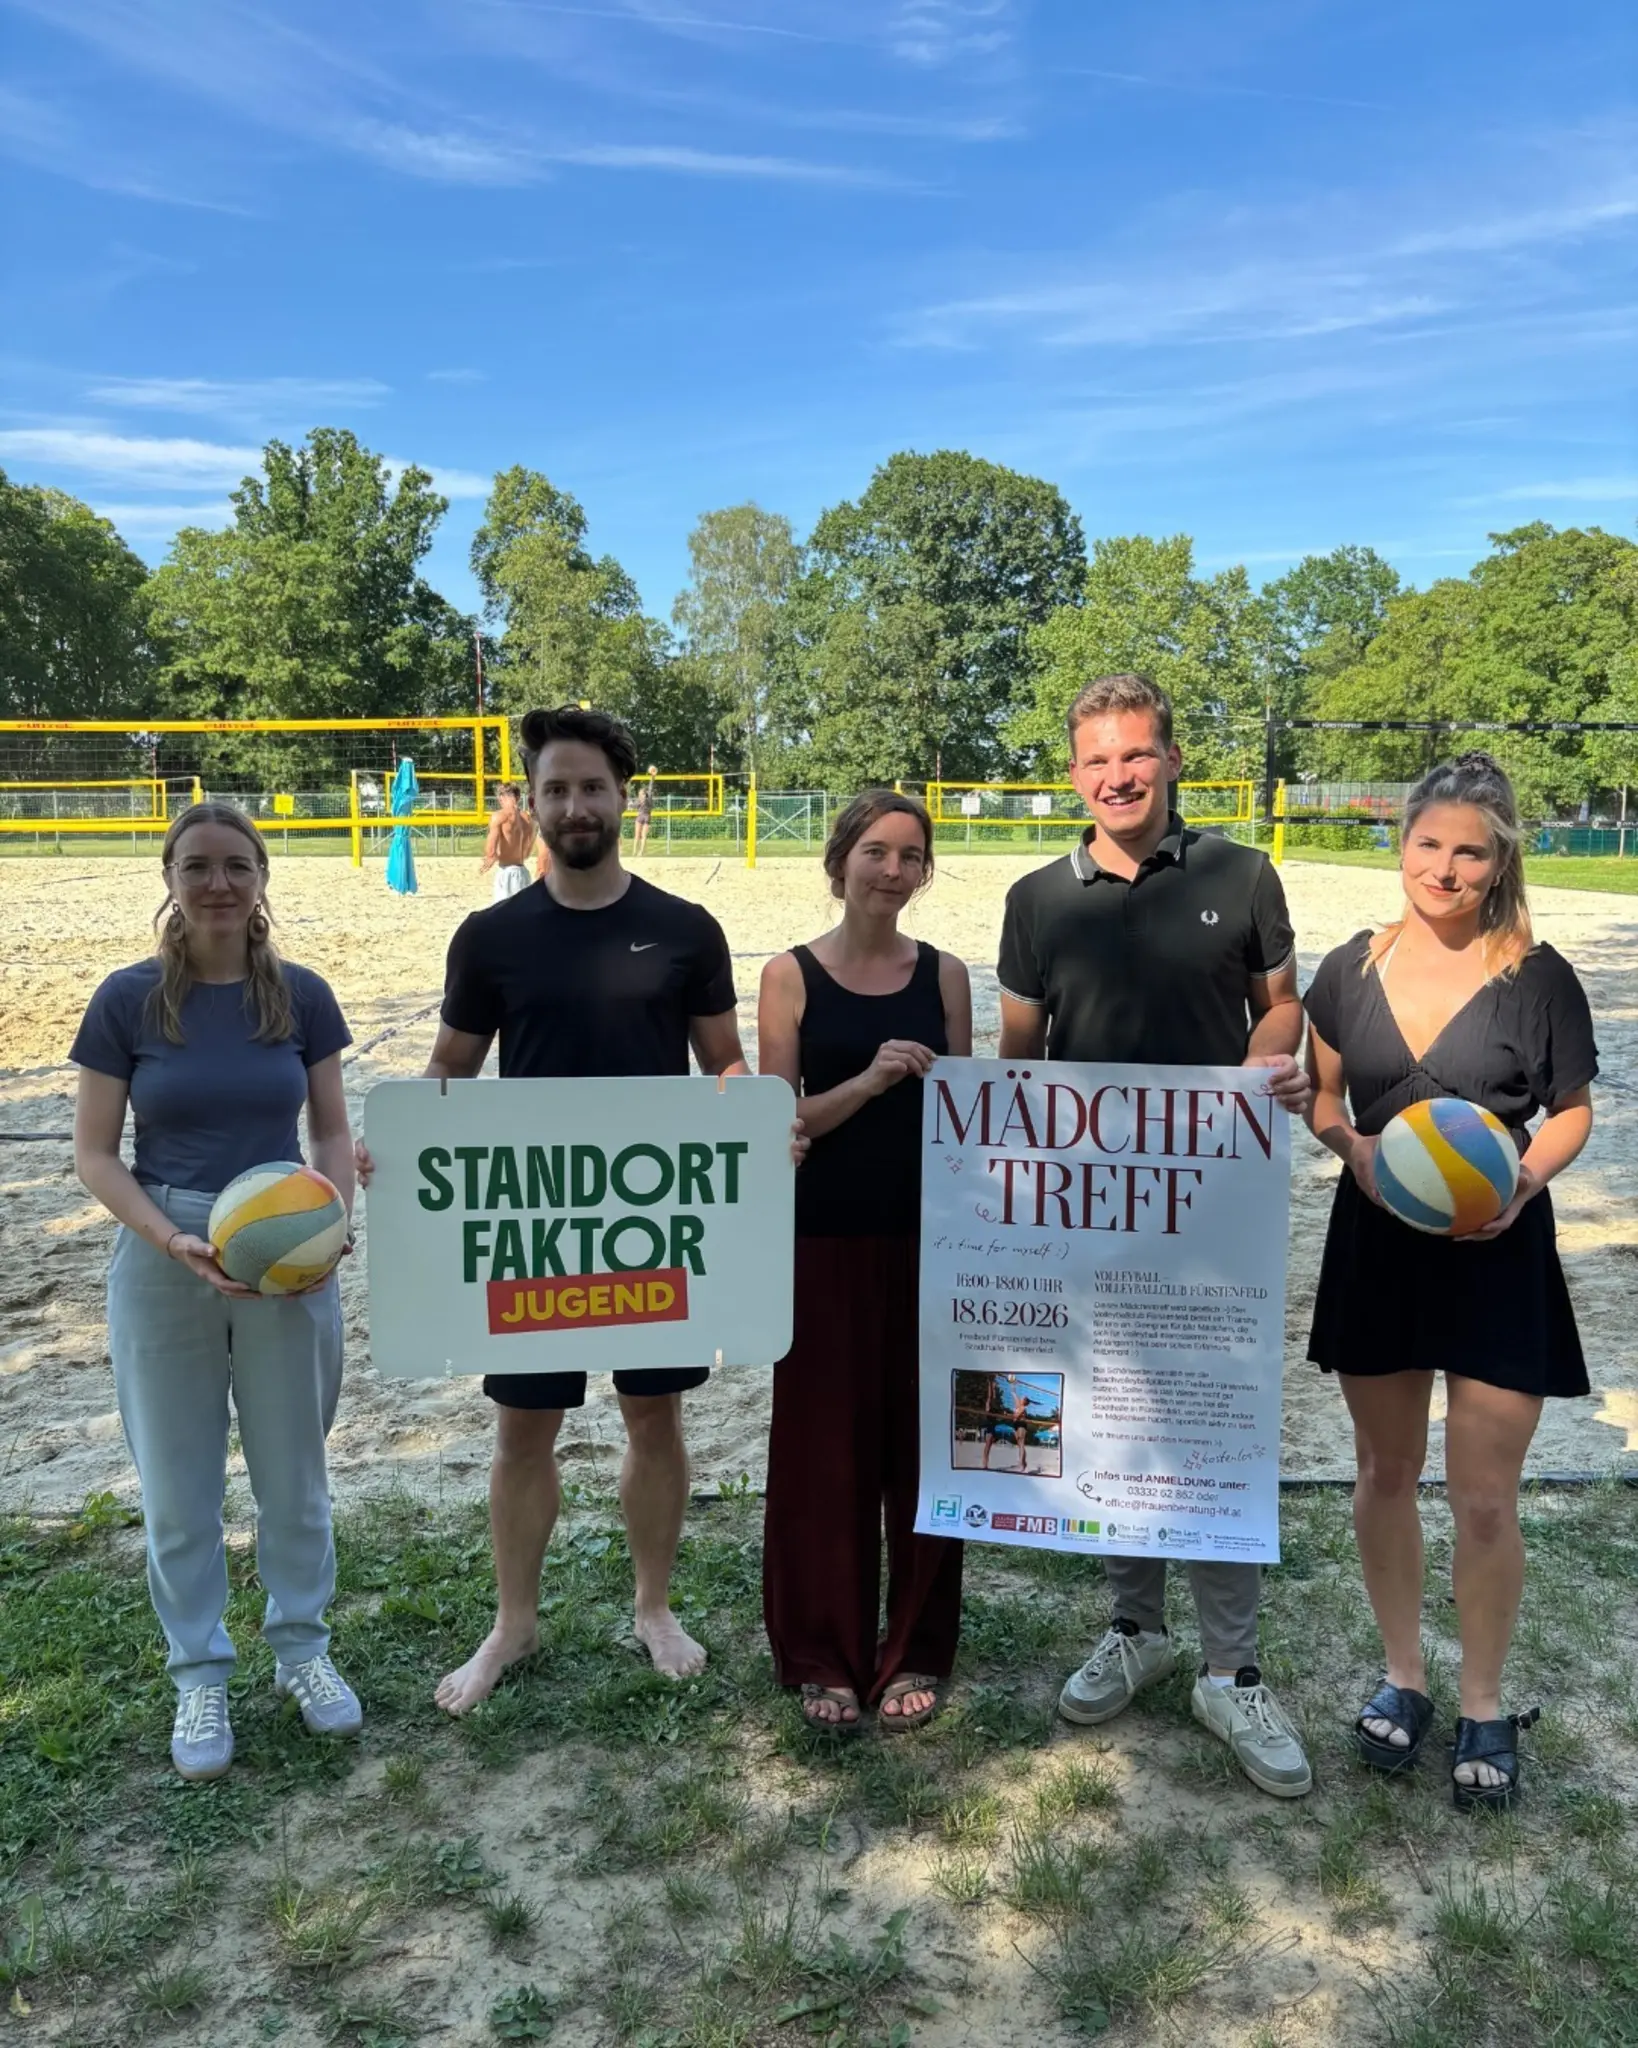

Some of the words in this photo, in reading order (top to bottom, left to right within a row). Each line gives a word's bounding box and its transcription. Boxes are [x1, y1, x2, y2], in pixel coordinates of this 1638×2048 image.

[931, 1070, 1274, 1160] MÄDCHEN
[417, 1142, 748, 1211] STANDORT
[988, 1158, 1202, 1234] TREFF
[463, 1214, 707, 1283] FAKTOR
[958, 1237, 984, 1251] time
[986, 1238, 1007, 1256] for
[1012, 1241, 1053, 1260] myself
[1033, 1278, 1063, 1293] UHR
[1094, 1269, 1160, 1283] VOLLEYBALL
[1094, 1281, 1187, 1296] VOLLEYBALLCLUB
[1190, 1282, 1268, 1299] FÜRSTENFELD
[500, 1281, 676, 1323] JUGEND
[952, 1298, 1069, 1328] 18.6.2026
[1202, 1448, 1252, 1465] kostenlos
[1094, 1470, 1120, 1481] Infos
[1123, 1473, 1143, 1483] und
[1145, 1475, 1216, 1488] ANMELDUNG
[1219, 1481, 1251, 1490] unter:
[1196, 1491, 1219, 1501] oder
[1015, 1516, 1057, 1533] FMB
